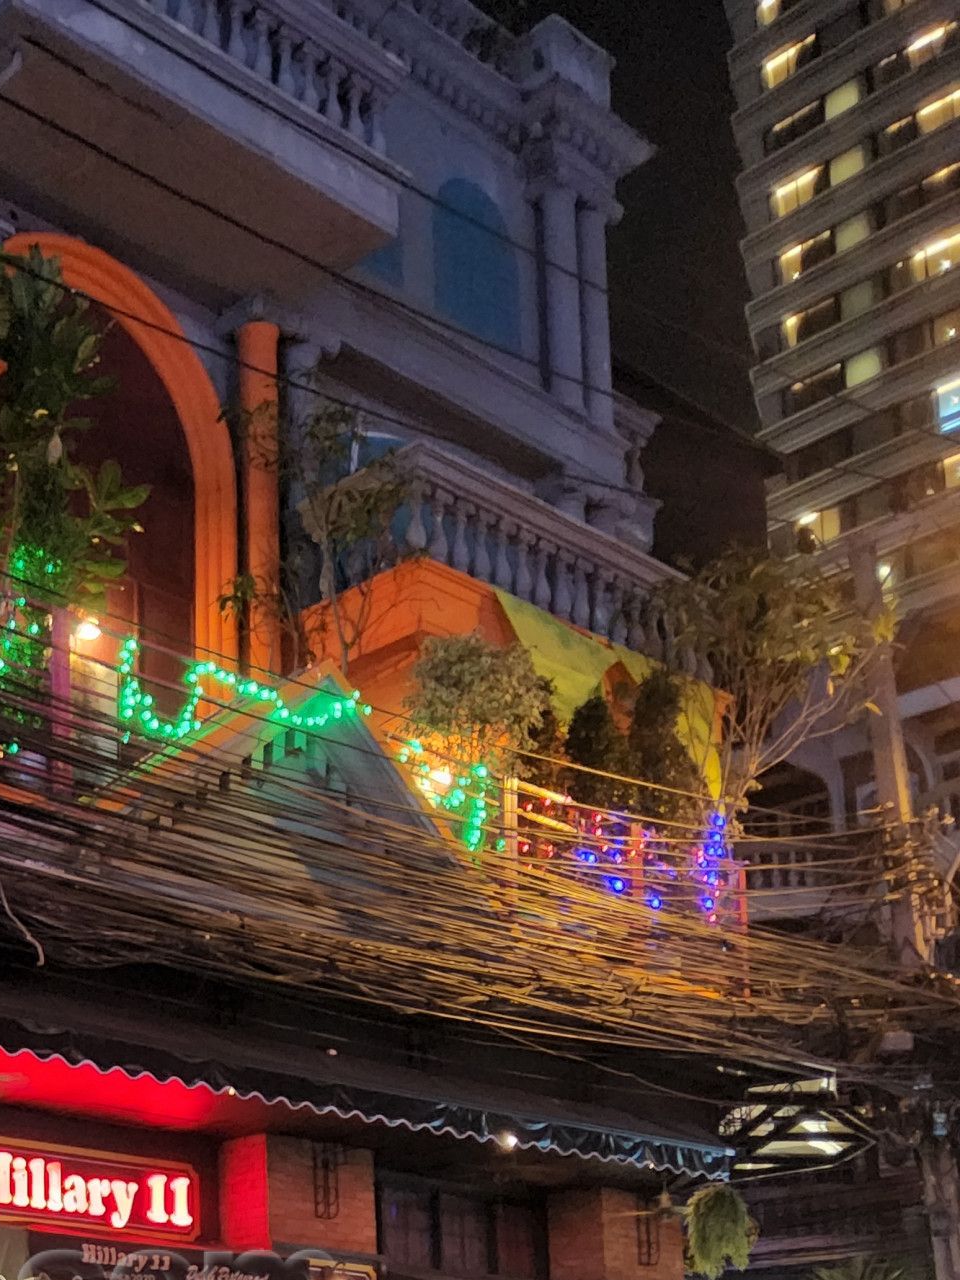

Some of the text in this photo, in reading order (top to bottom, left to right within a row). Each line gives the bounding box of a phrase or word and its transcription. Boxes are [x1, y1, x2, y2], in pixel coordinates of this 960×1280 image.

[146, 1174, 193, 1227] 11
[82, 1243, 171, 1273] Hillary 11
